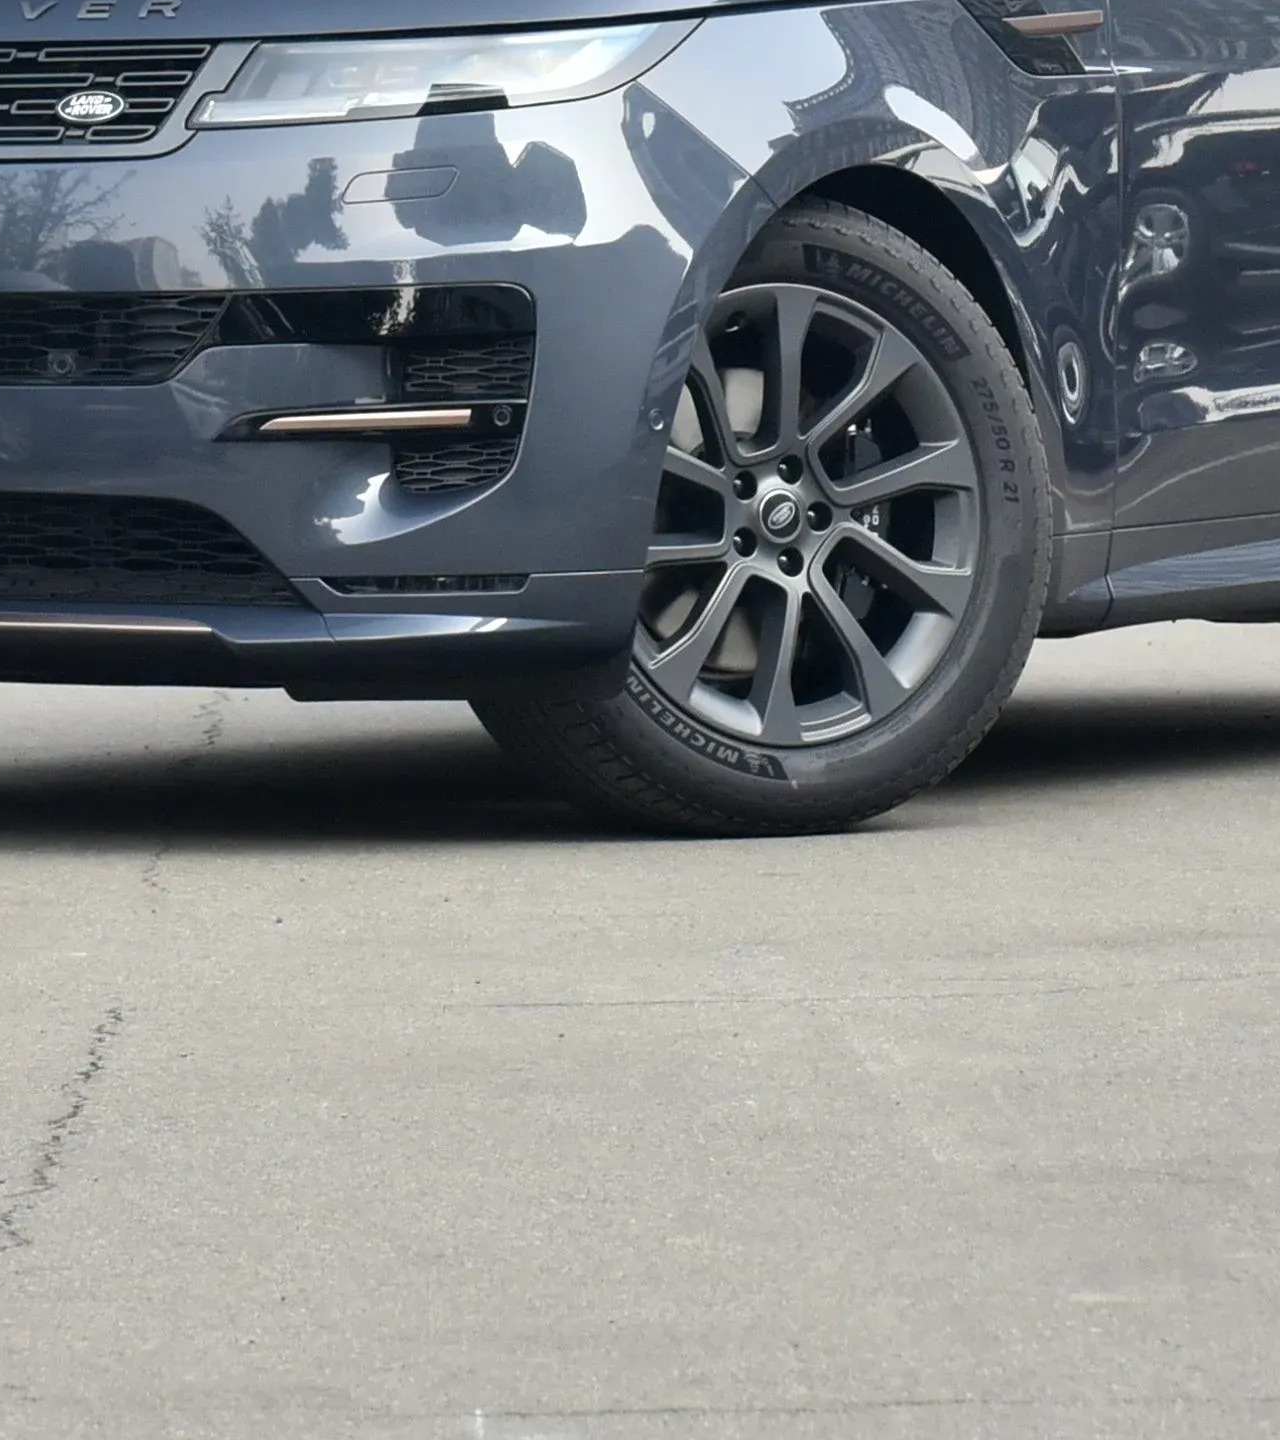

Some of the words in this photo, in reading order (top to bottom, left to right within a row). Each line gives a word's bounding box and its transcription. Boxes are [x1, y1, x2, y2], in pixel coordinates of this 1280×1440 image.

[70, 95, 104, 105] LAND
[71, 104, 113, 115] ROVER
[846, 263, 961, 356] MICHELIN
[971, 375, 1012, 452] 275/50
[999, 458, 1016, 473] R
[1002, 480, 1020, 505] 21
[625, 675, 740, 765] MICHELIN
